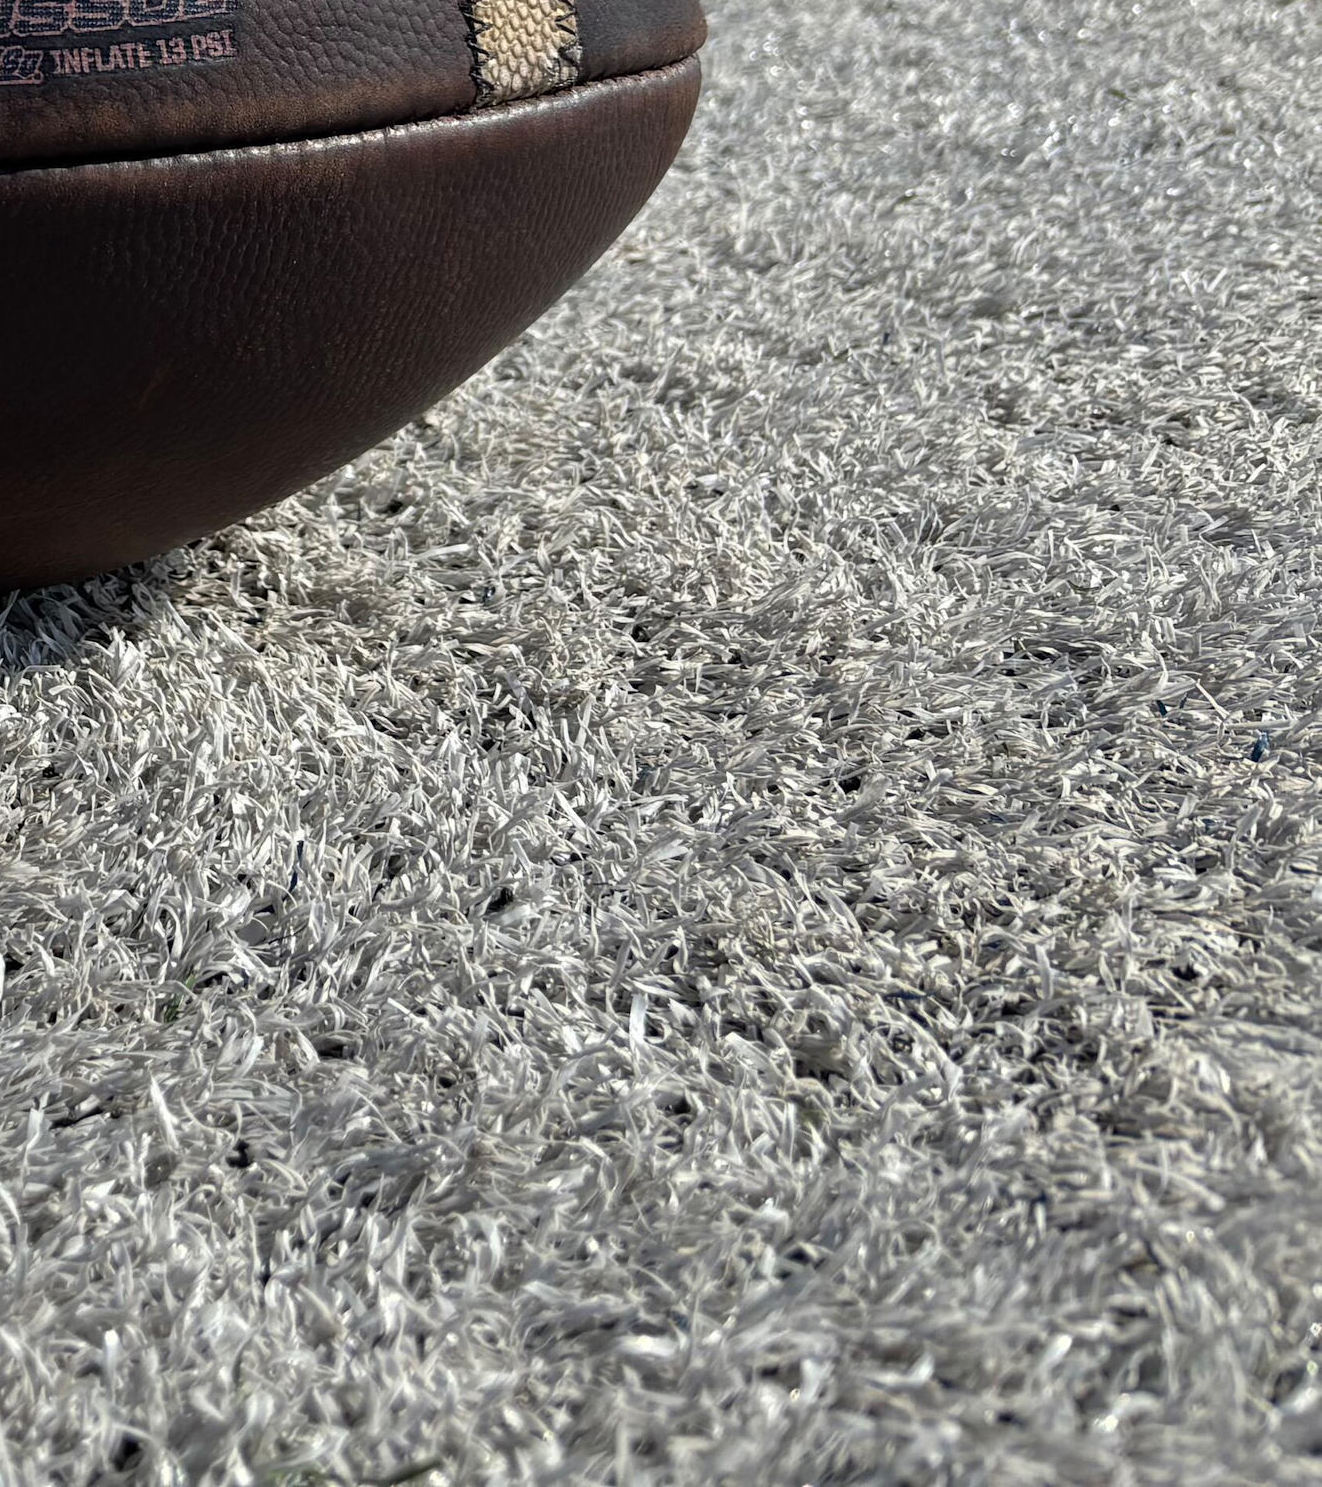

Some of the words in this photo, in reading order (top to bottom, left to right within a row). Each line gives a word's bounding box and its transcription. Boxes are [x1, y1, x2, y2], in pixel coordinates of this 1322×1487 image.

[49, 41, 153, 75] INFLATE
[156, 37, 187, 65] 13
[190, 29, 237, 61] PSI
